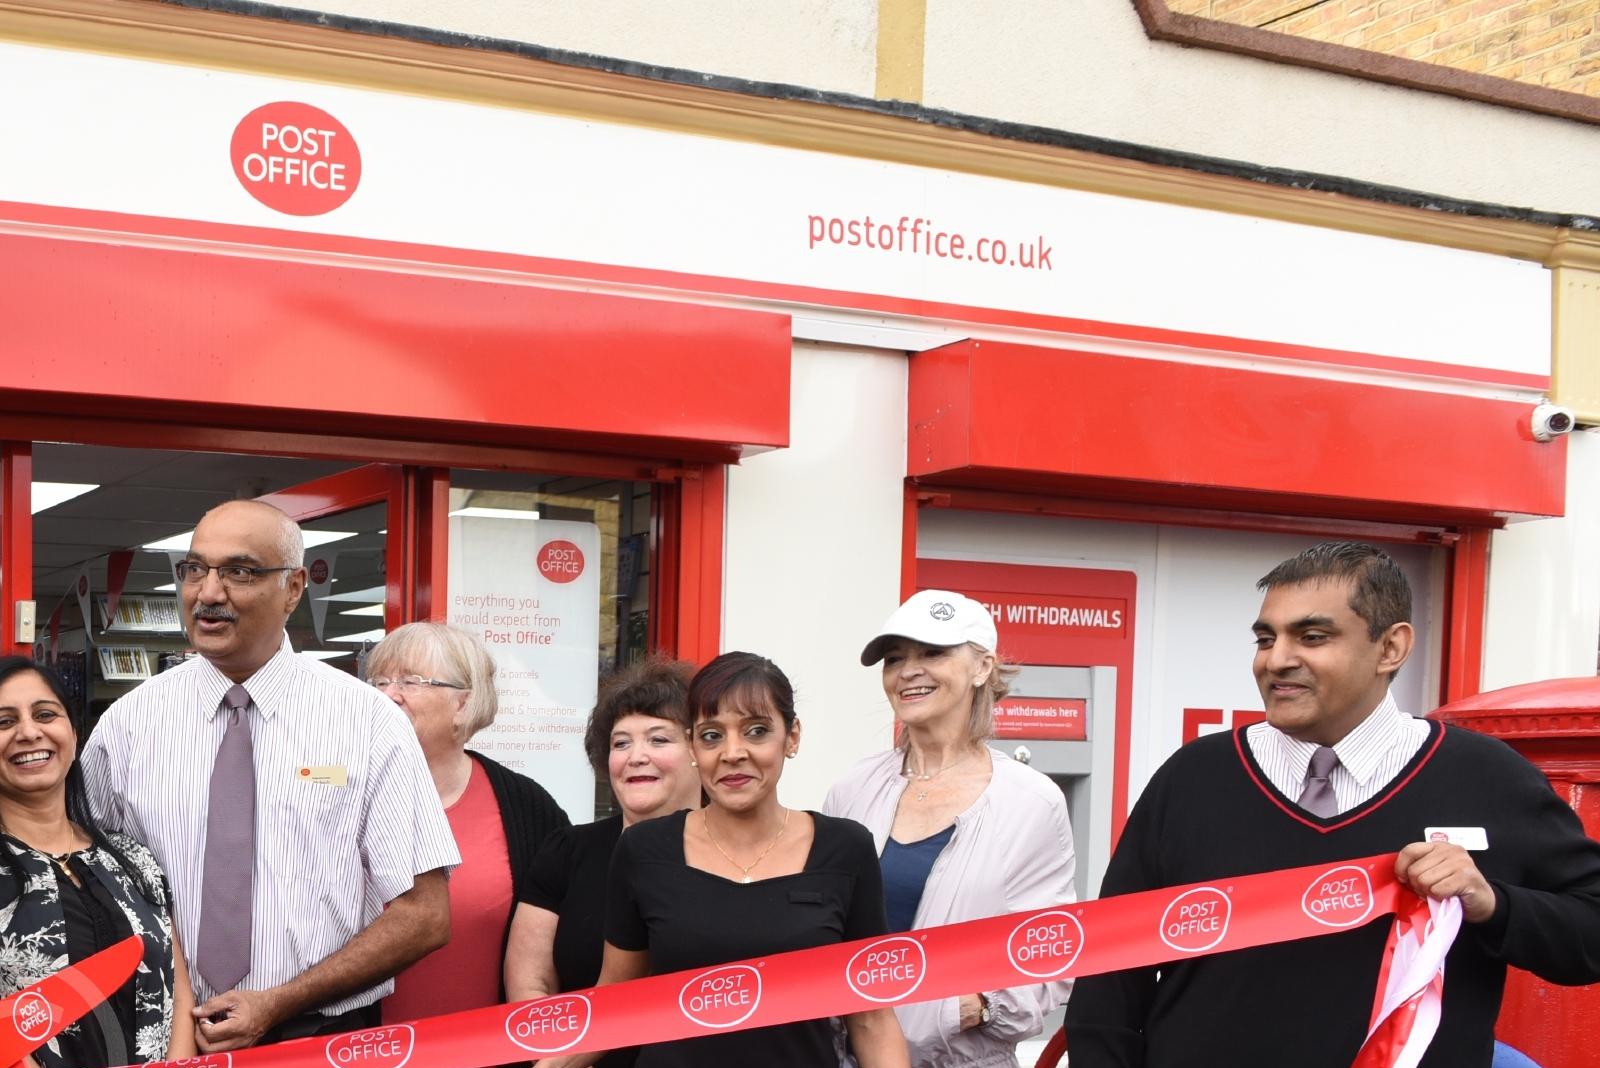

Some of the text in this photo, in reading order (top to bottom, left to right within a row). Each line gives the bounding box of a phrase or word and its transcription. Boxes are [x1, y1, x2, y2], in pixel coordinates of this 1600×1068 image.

[262, 122, 336, 157] POST
[243, 153, 346, 190] OFFICE
[808, 215, 1052, 270] postoffice.co.uk
[548, 549, 575, 560] POST
[541, 561, 579, 573] OFFICE
[455, 593, 540, 610] everything you
[455, 612, 561, 627] would expect from
[984, 604, 1121, 628] SH WITHDRAWALS
[485, 630, 511, 643] Post
[509, 670, 539, 679] parcels
[527, 705, 576, 718] homephone
[1007, 706, 1057, 717] withdrawals
[1059, 706, 1078, 717] here
[491, 724, 526, 734] deposits
[539, 724, 587, 735] withdrawals
[468, 741, 561, 752] global money transfer
[499, 759, 526, 767] ments
[1319, 877, 1360, 896] POST
[1179, 900, 1219, 918] POST
[1310, 893, 1365, 914] OFFICE
[1026, 923, 1067, 943] POST
[1167, 917, 1220, 938] OFFICE
[866, 948, 909, 966] POST
[1017, 940, 1073, 961] OFFICE
[700, 974, 746, 993] POST
[856, 965, 915, 987] OFFICE
[20, 1000, 40, 1019] POST
[528, 1001, 575, 1018] POST
[689, 989, 750, 1013] OFFICE
[21, 1010, 48, 1032] OFFICE
[516, 1015, 579, 1037] OFFICE
[349, 1028, 398, 1044] POST
[337, 1040, 401, 1063] OFFICE
